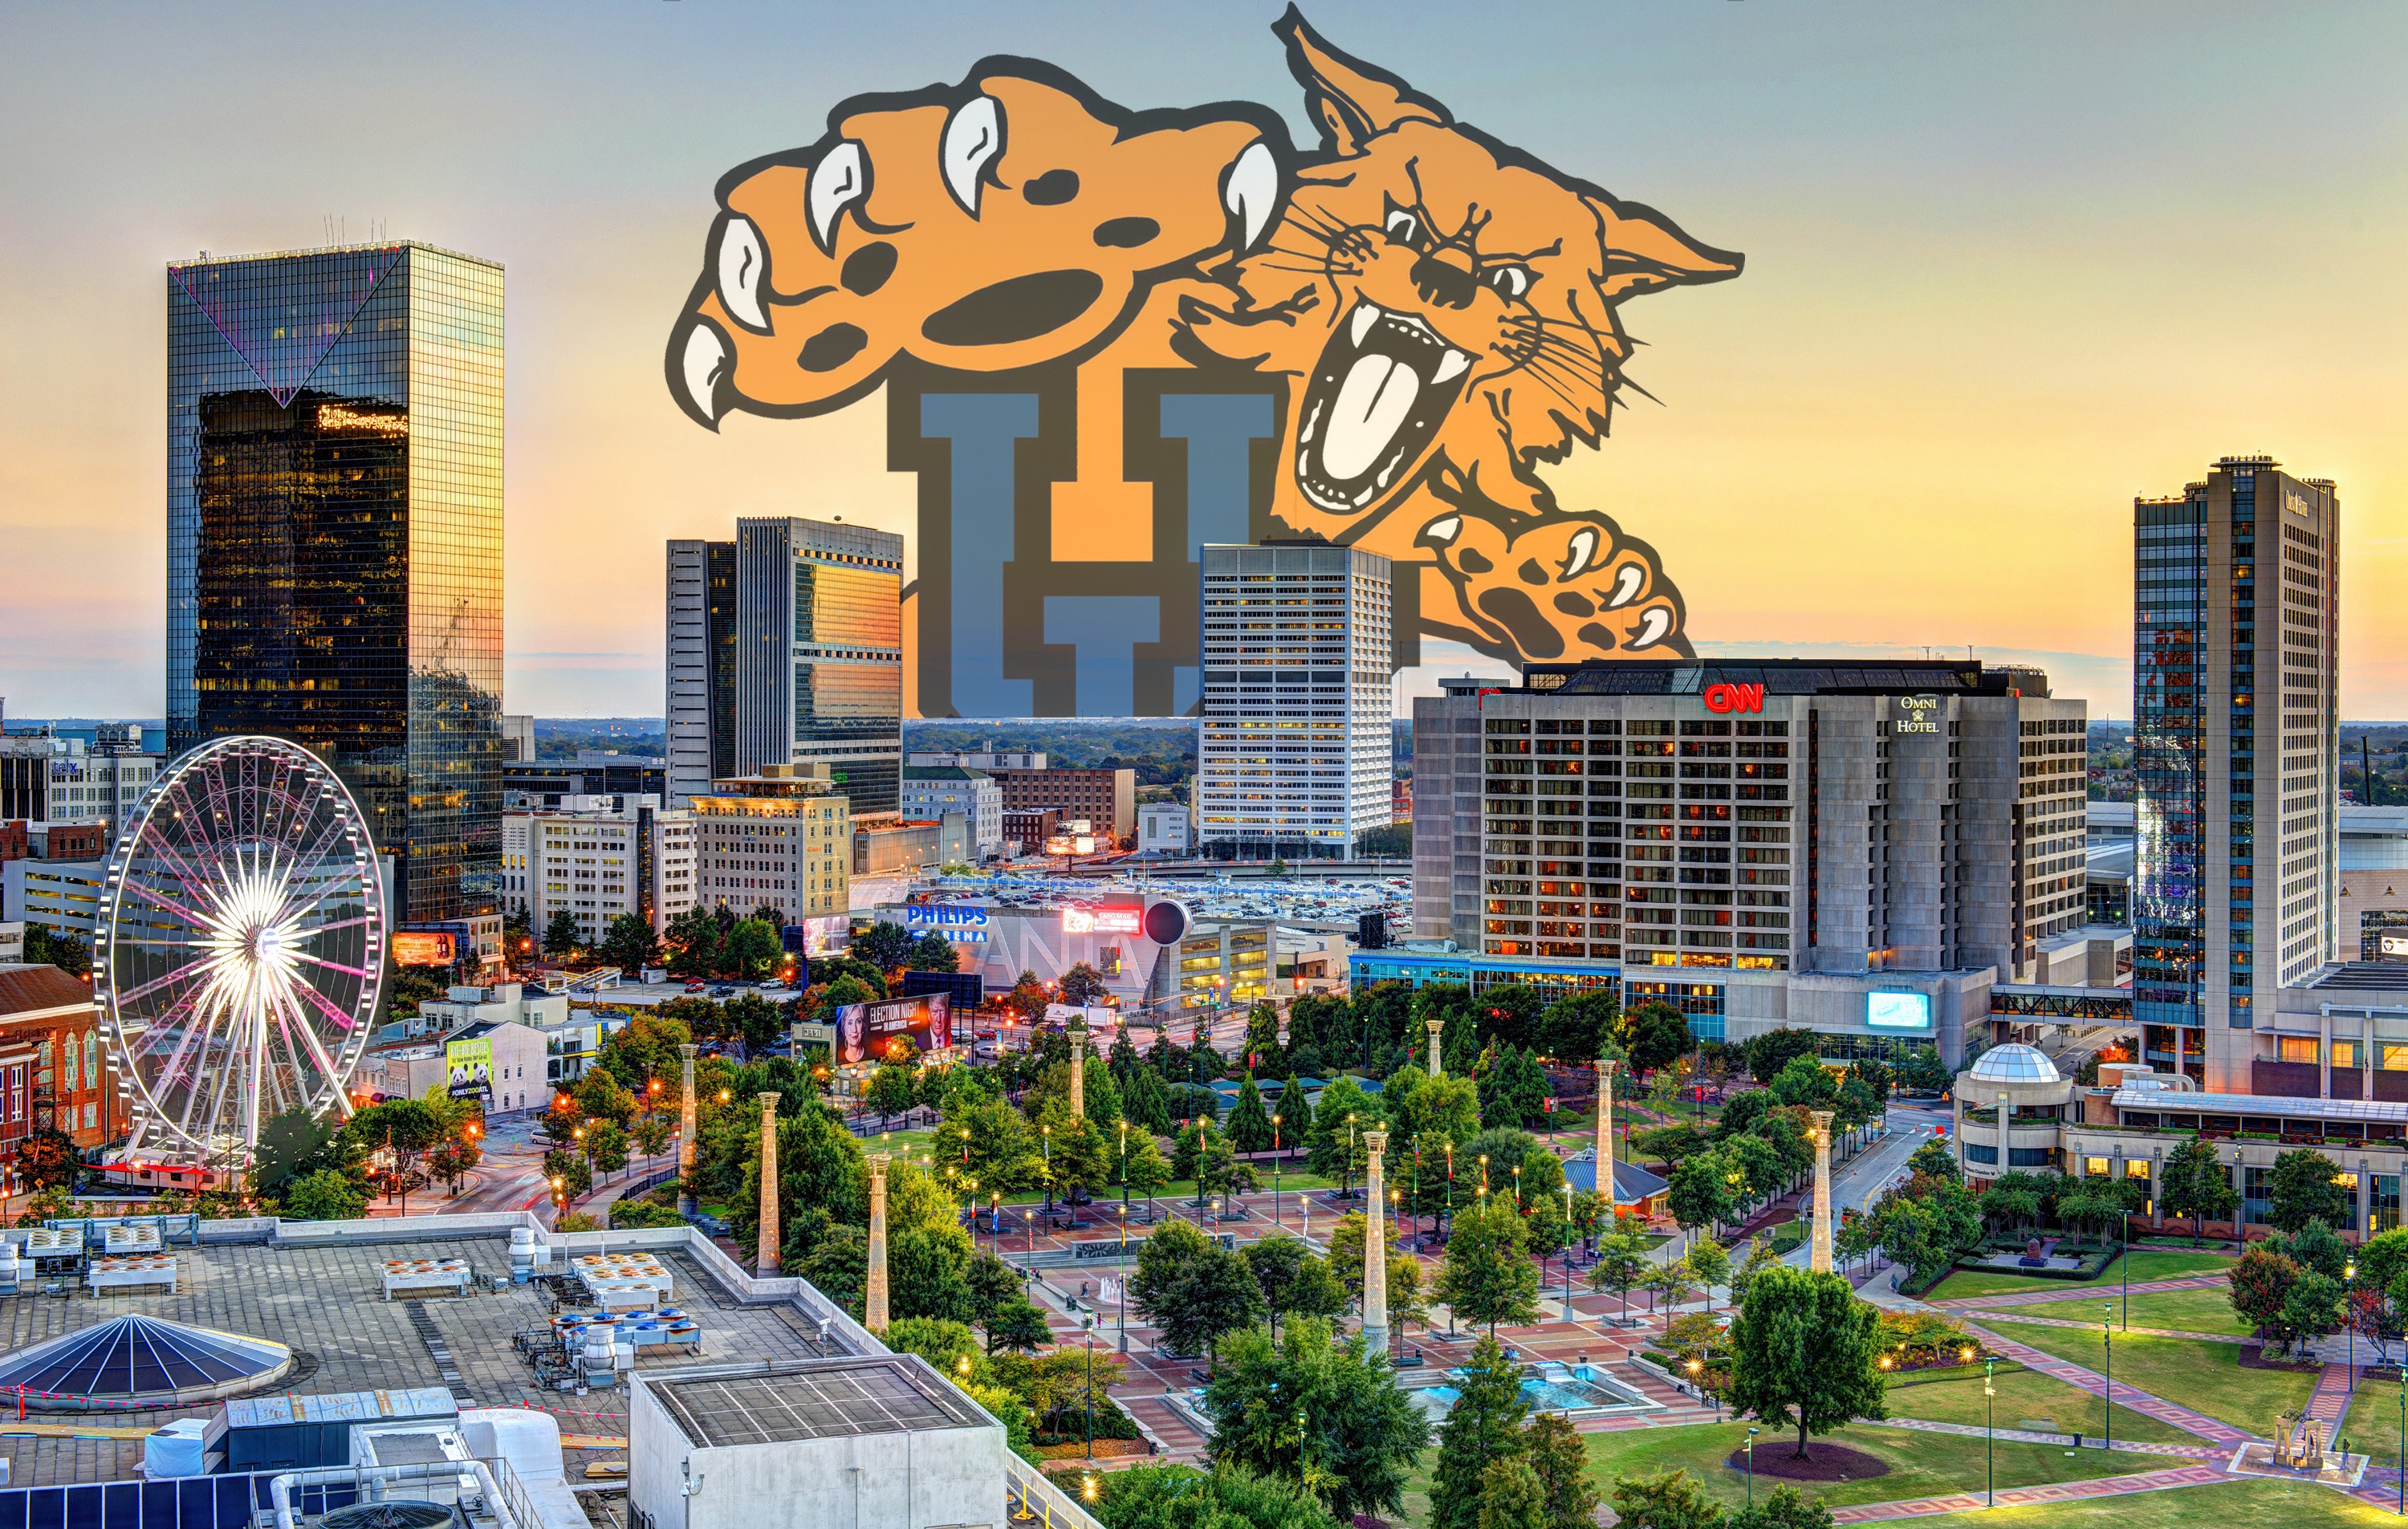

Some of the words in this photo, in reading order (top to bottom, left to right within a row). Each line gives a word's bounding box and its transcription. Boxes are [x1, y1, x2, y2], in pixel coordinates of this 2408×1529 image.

[1704, 683, 1763, 713] CNN
[1901, 696, 1937, 709] OMNI
[1897, 720, 1940, 732] HOTEL
[53, 758, 78, 775] telx
[908, 905, 988, 925] PHILIPS
[932, 930, 986, 941] RENA
[870, 1003, 901, 1023] ELECTION
[901, 1001, 921, 1019] NIGHT
[884, 1022, 889, 1031] IN
[889, 1020, 907, 1031] AMERICA
[450, 1043, 470, 1057] BYE-BYE
[470, 1041, 490, 1055] BESTIES
[452, 1085, 488, 1096] #ONLYZOOATL
